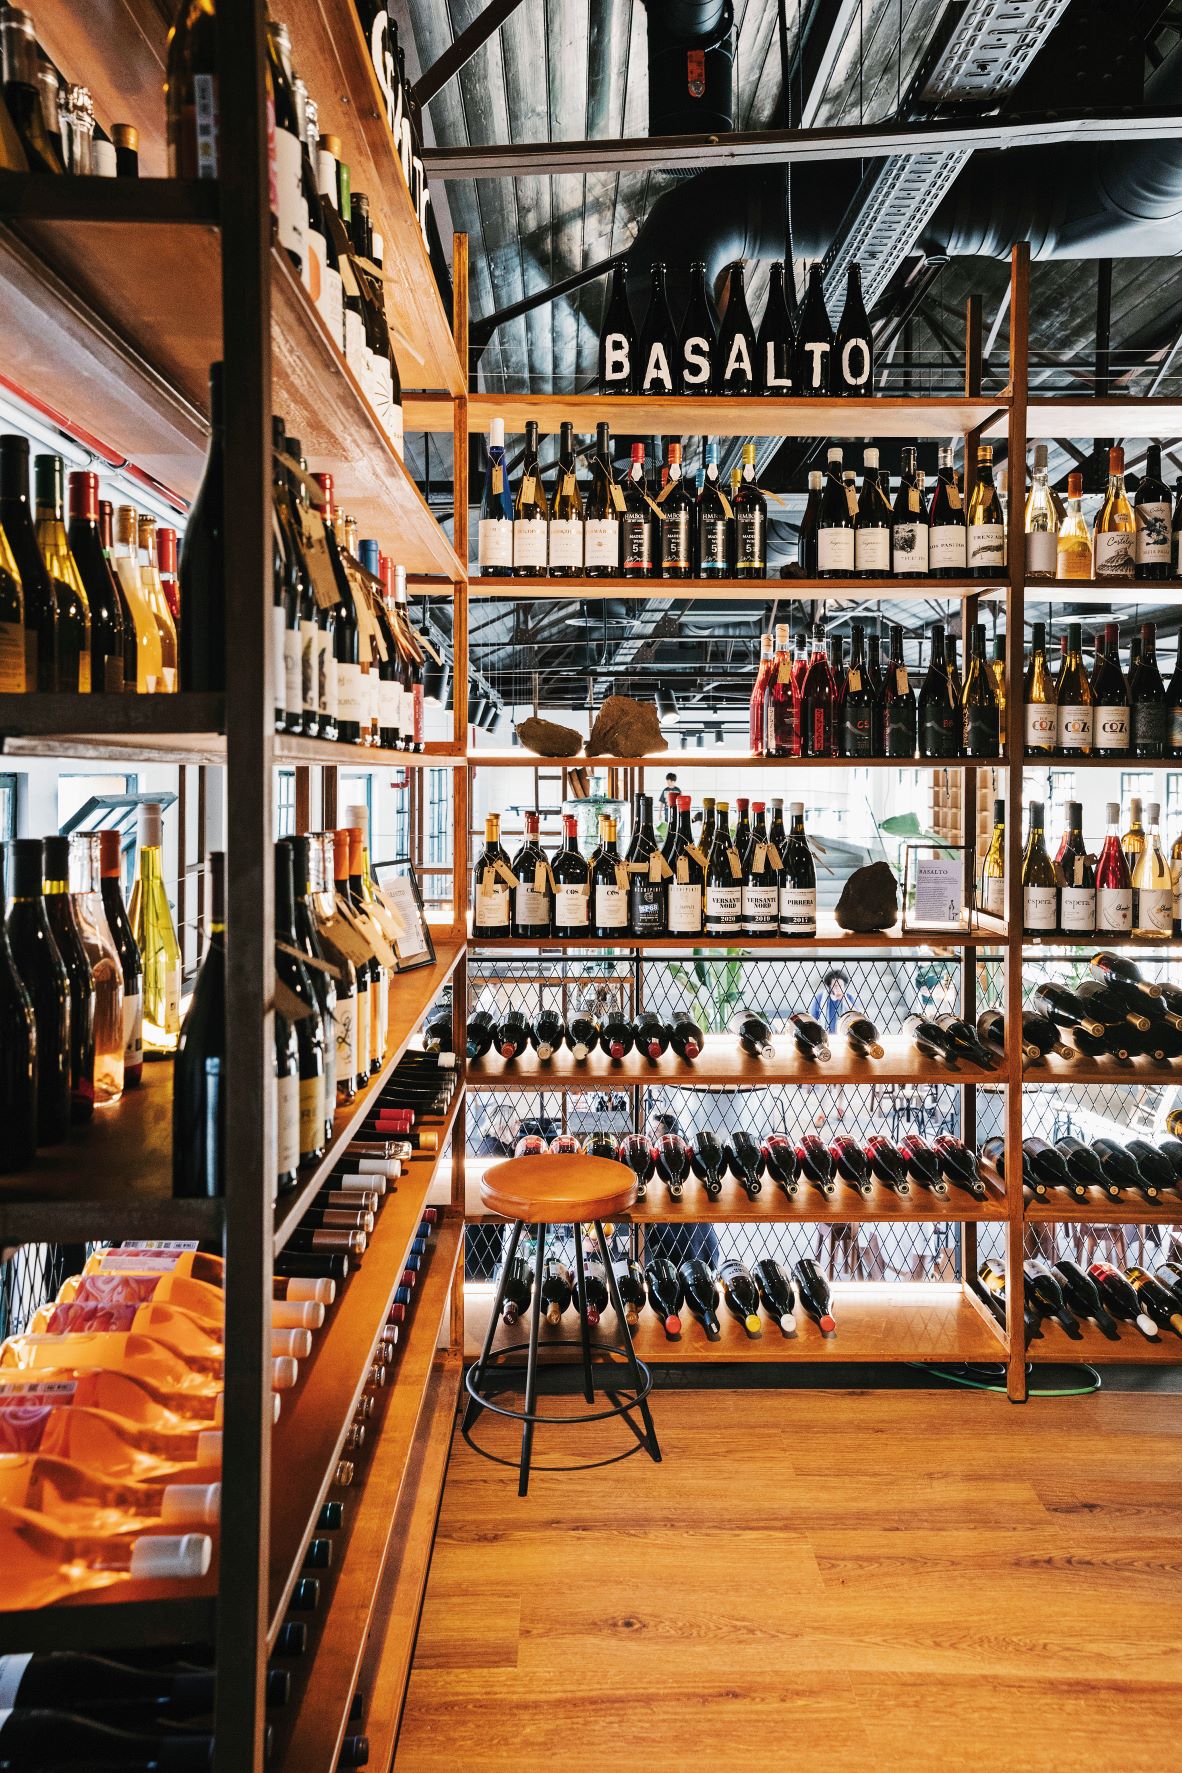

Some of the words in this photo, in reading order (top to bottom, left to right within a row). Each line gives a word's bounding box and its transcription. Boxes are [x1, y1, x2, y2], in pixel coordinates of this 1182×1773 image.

[605, 333, 871, 390] BASALTO
[632, 544, 639, 553] 5
[670, 543, 677, 552] 5
[711, 544, 718, 553] 5
[745, 544, 753, 553] 5
